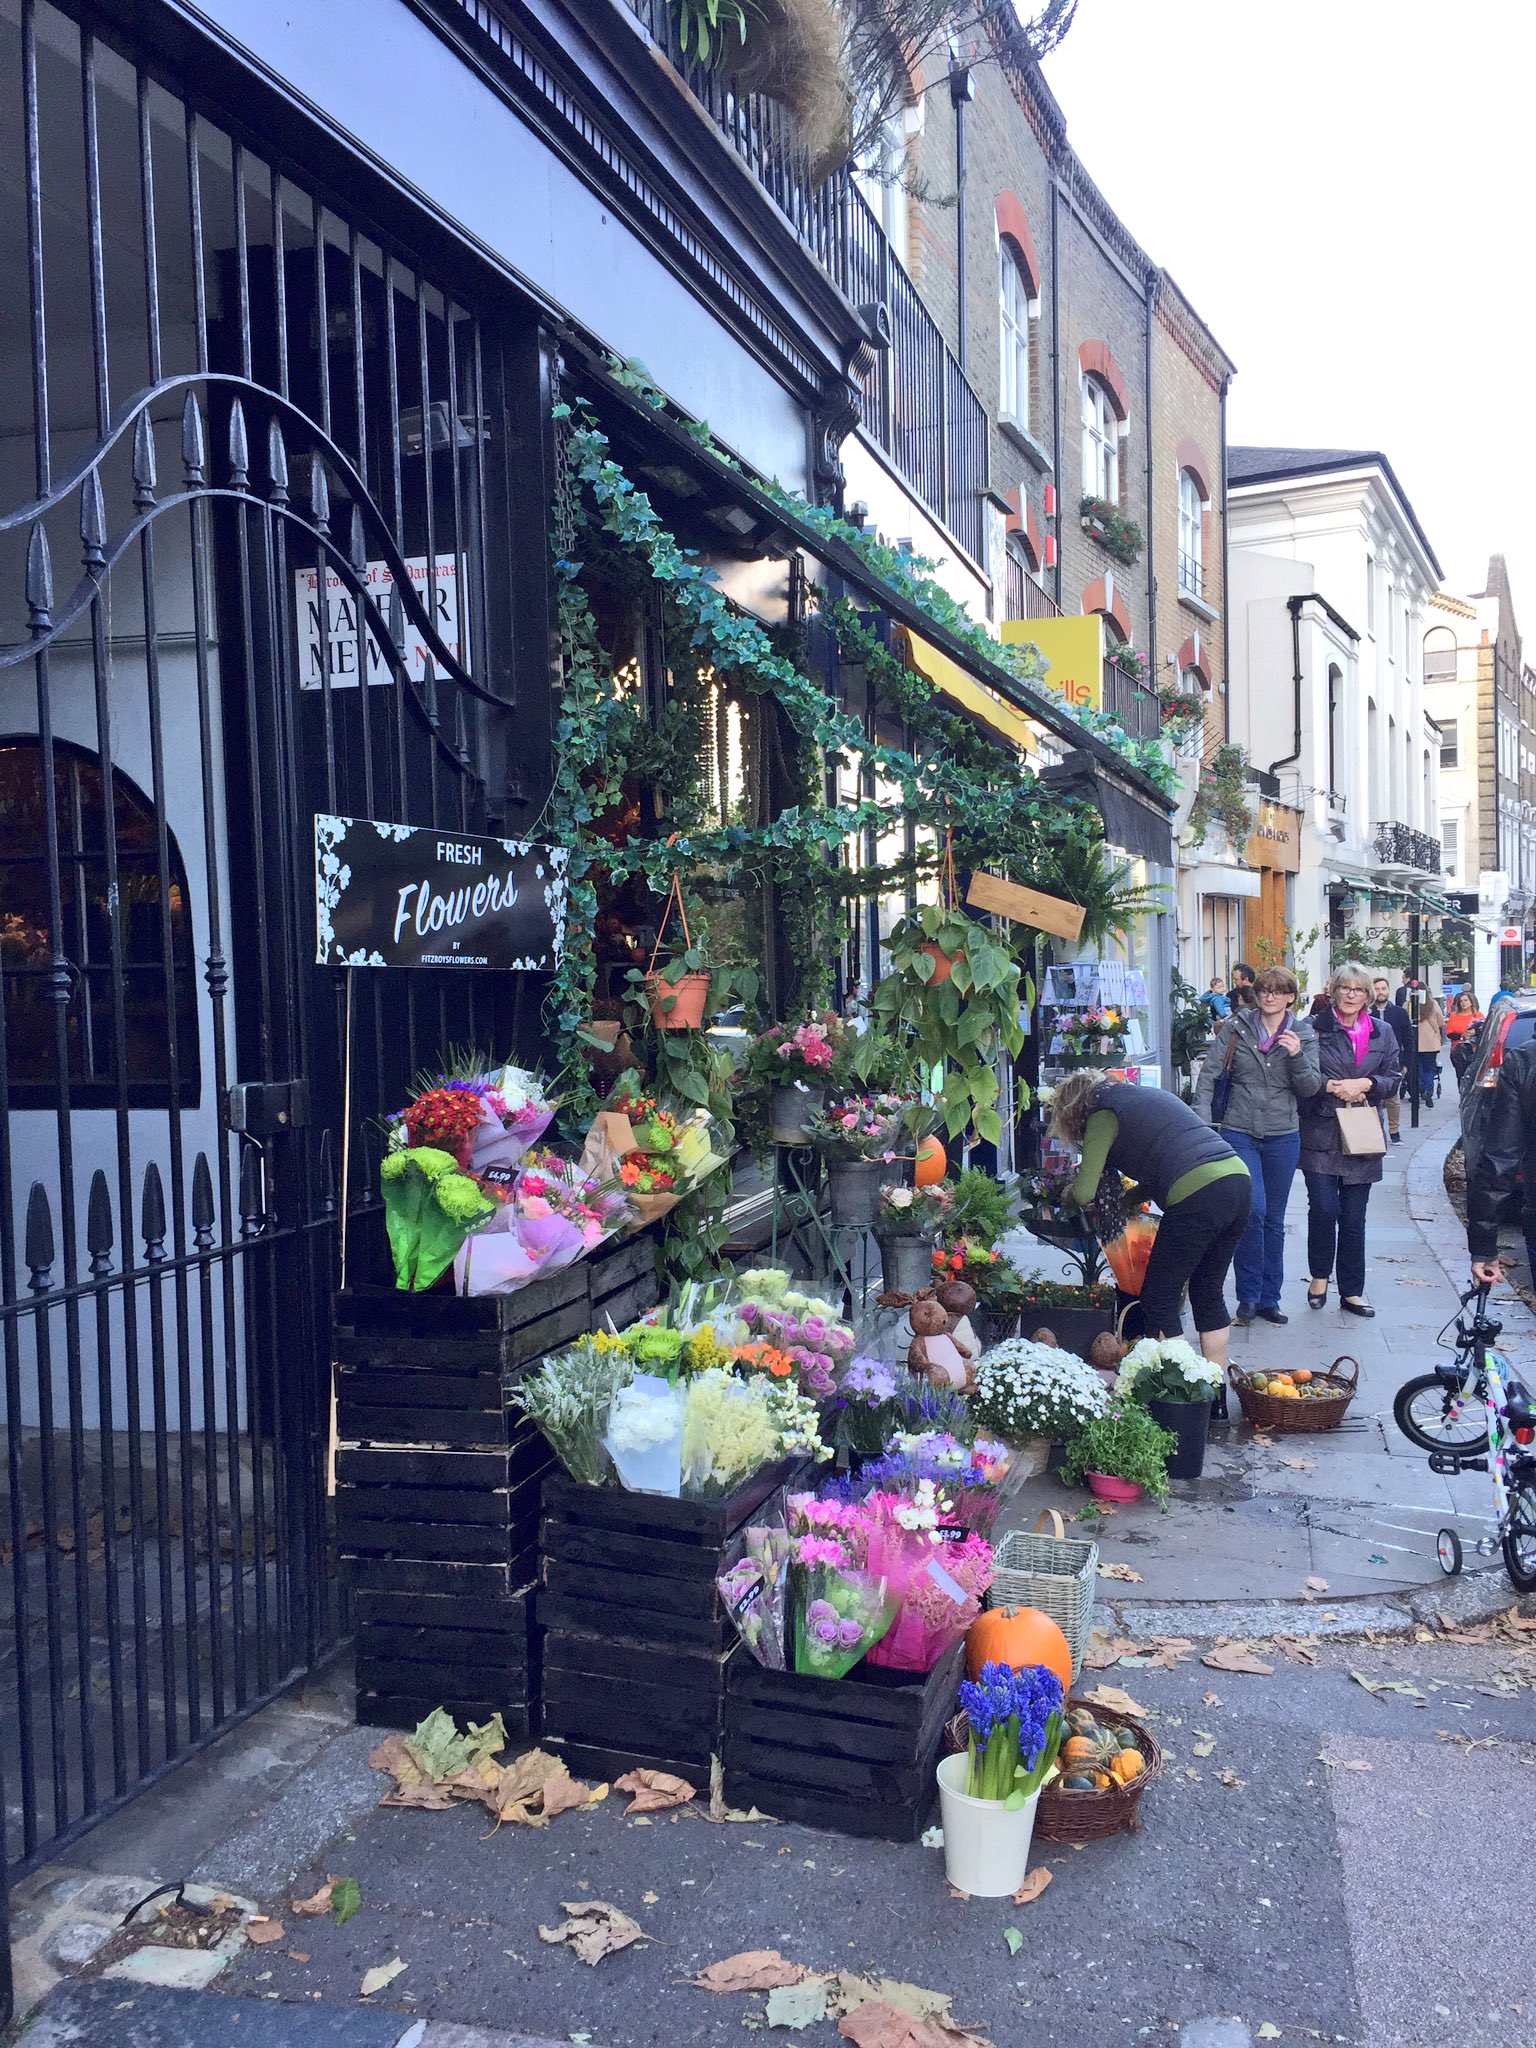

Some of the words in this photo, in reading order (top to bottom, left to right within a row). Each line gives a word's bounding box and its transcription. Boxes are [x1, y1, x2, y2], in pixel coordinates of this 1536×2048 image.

[436, 841, 482, 866] FRESH
[394, 870, 519, 944] Flowers
[452, 941, 461, 950] BY
[421, 954, 488, 965] FITZROYSFLOWERS.COM
[487, 1170, 511, 1181] £4.99
